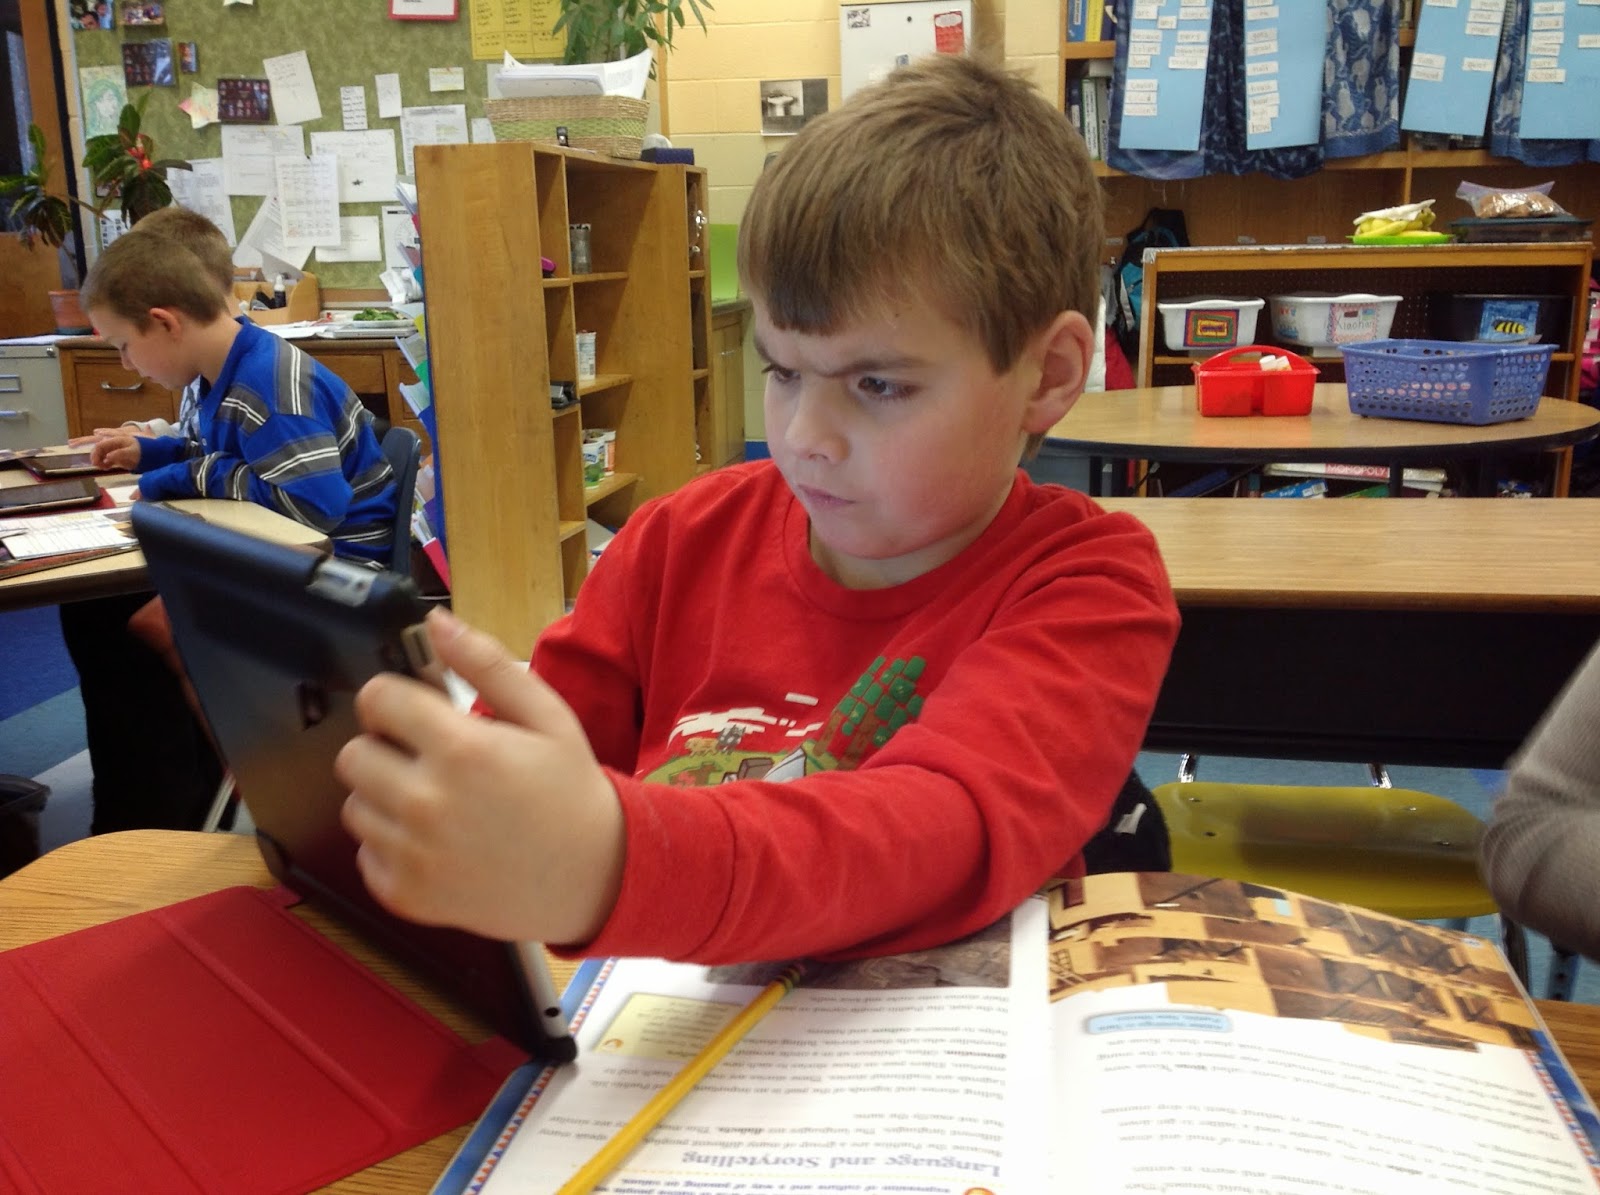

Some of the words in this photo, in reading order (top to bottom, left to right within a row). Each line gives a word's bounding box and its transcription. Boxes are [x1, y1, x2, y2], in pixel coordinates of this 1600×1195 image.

[1327, 464, 1386, 477] MONOPOLY
[682, 1152, 820, 1168] Storytelling
[830, 1157, 876, 1168] and
[884, 1154, 999, 1177] Language
